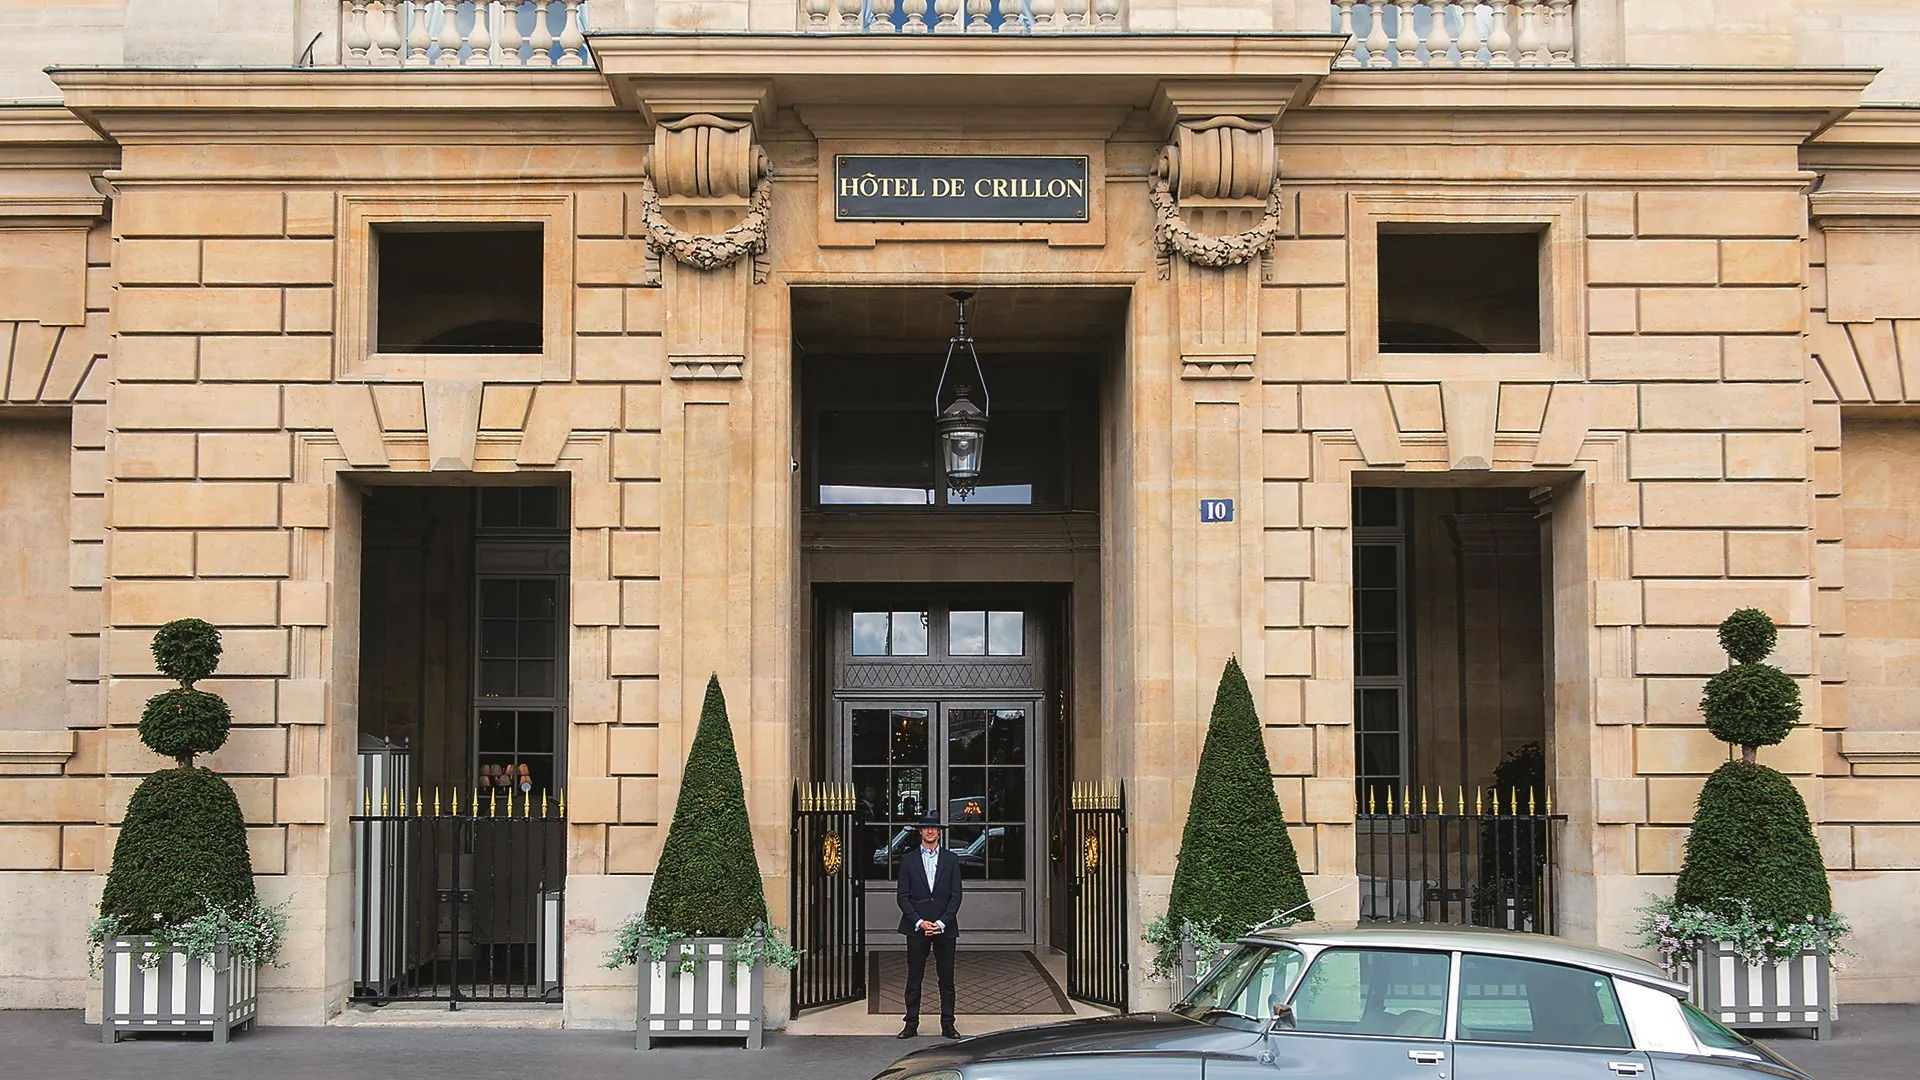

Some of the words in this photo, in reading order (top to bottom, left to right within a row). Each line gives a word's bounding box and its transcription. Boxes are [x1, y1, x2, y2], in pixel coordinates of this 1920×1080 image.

[840, 173, 925, 197] HÔTEL
[931, 178, 966, 198] DE
[974, 178, 1084, 198] CRILLON
[1208, 502, 1226, 519] 10
